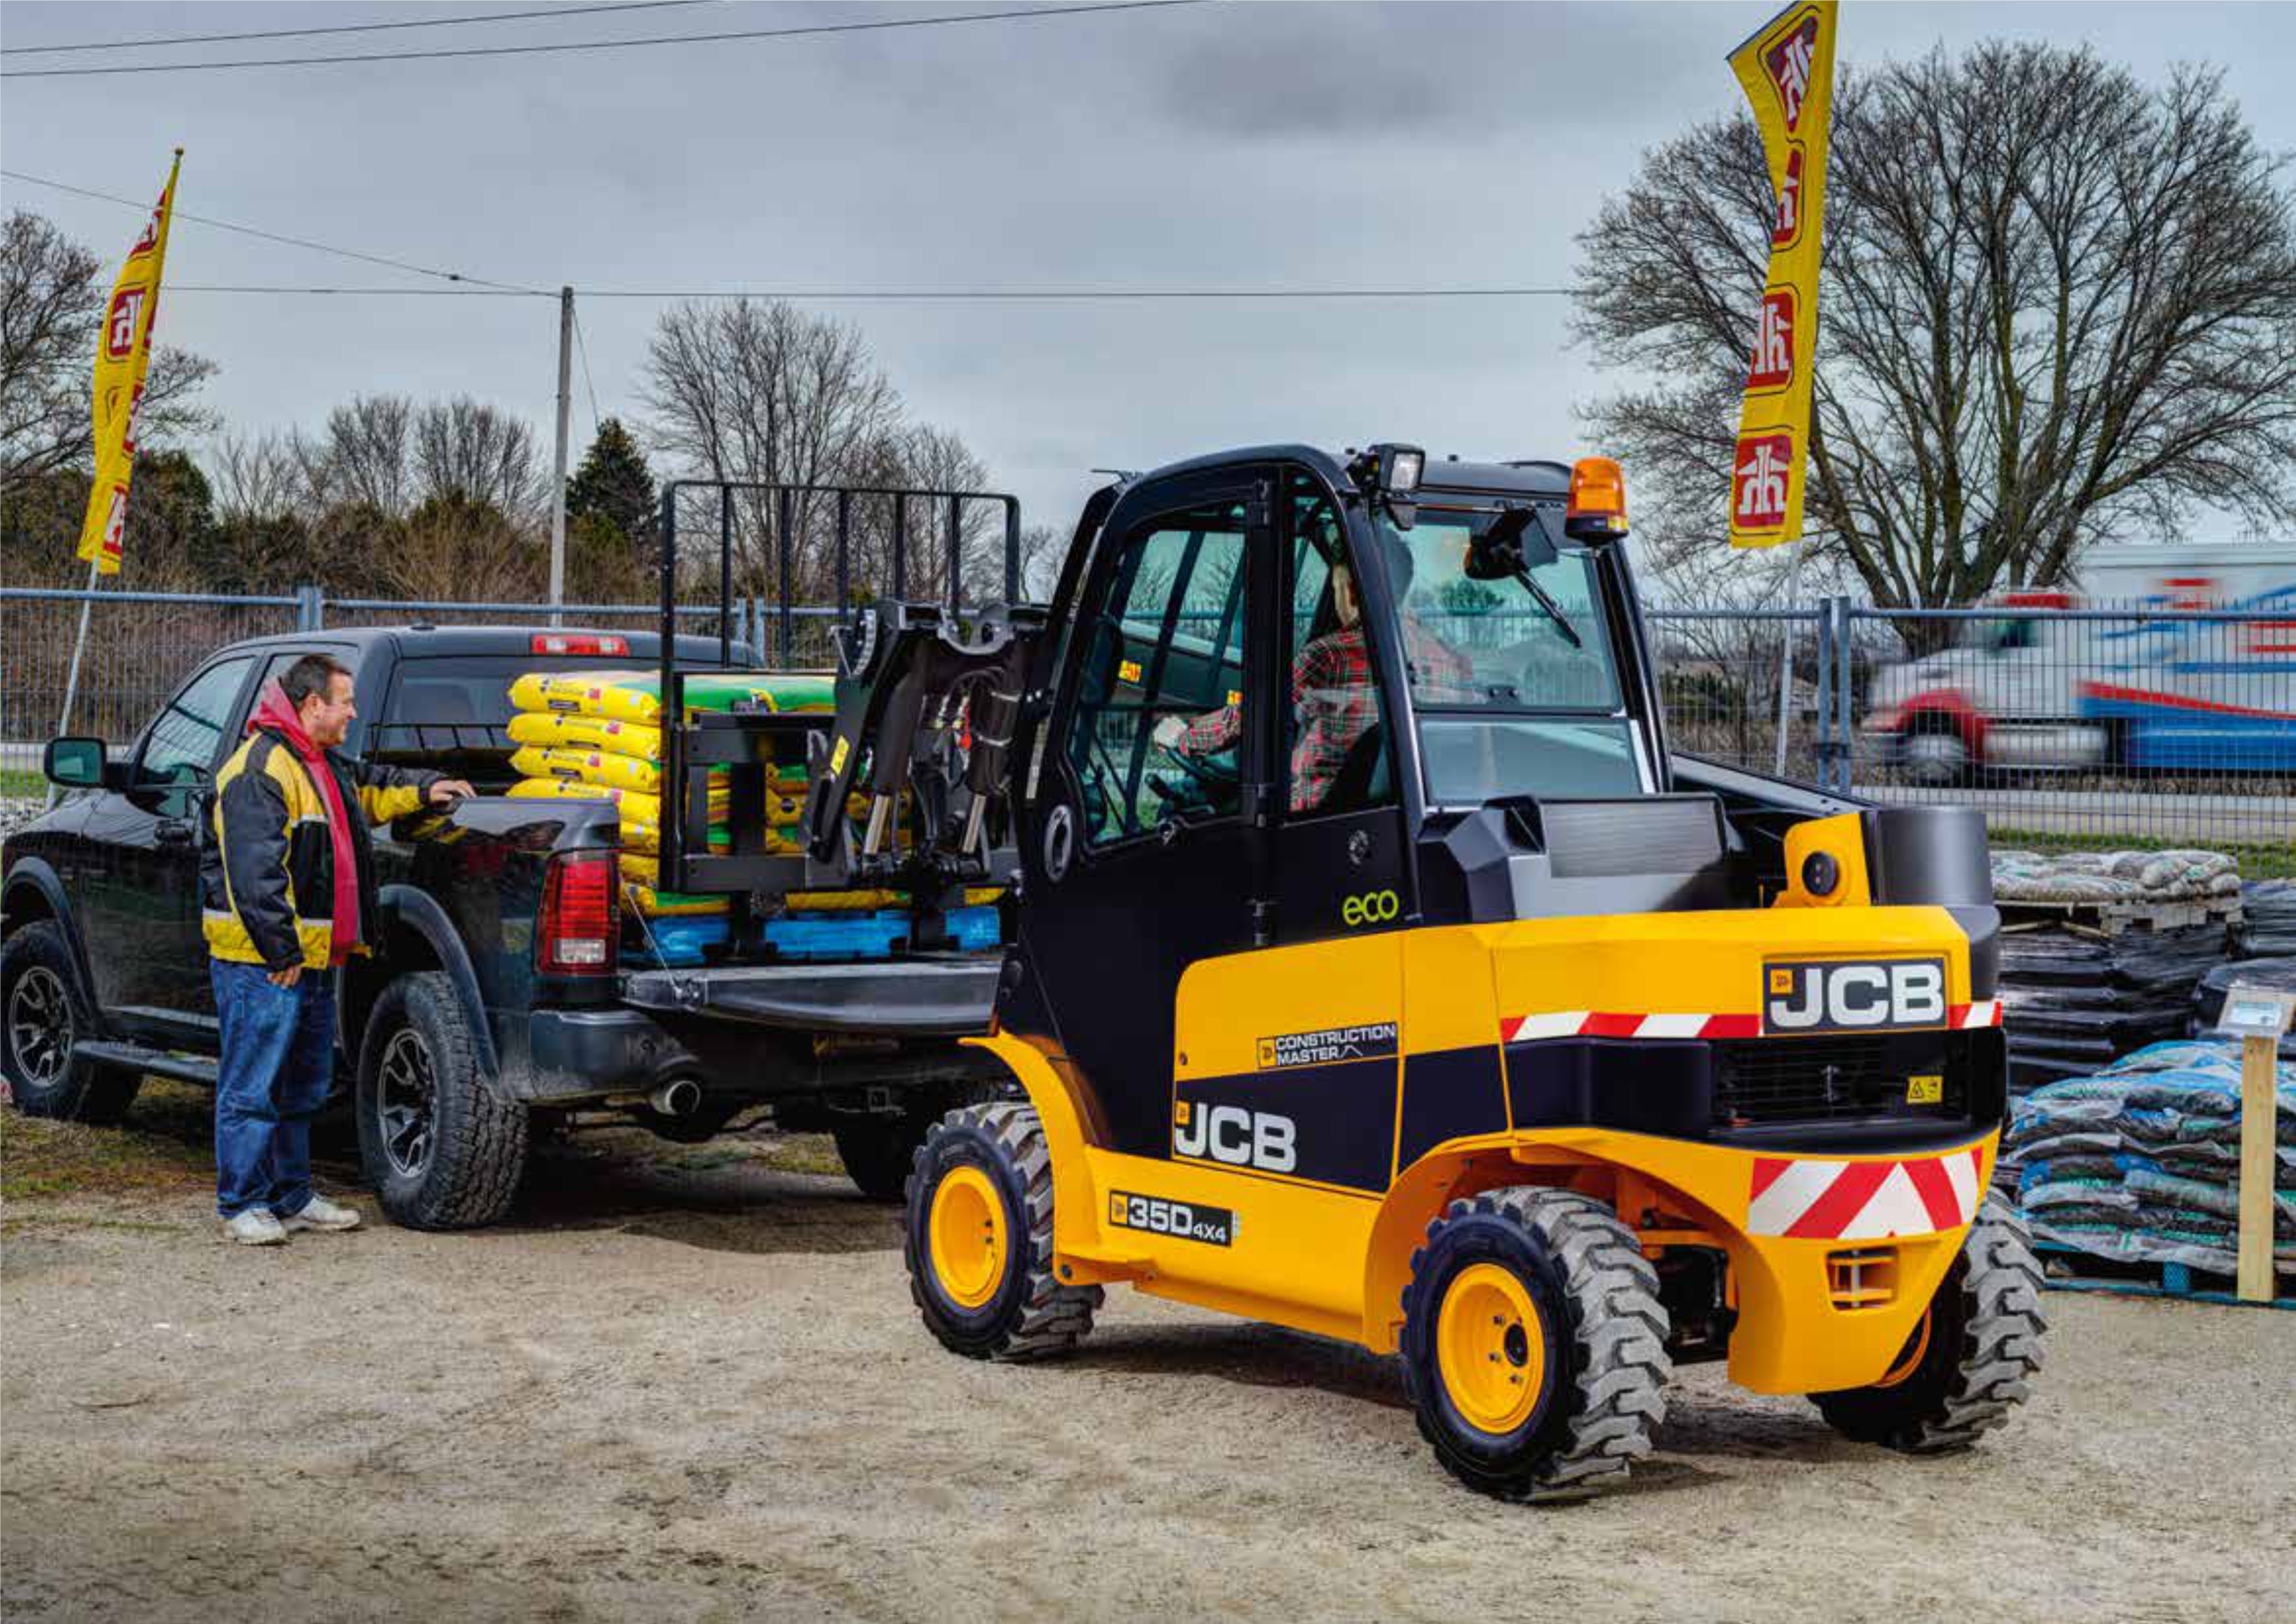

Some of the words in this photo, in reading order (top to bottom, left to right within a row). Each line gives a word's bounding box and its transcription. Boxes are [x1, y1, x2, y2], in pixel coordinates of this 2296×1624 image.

[1343, 890, 1399, 926] eco
[1770, 964, 1944, 1027] JCB
[1276, 1024, 1396, 1050] CONSTRUCTION
[1277, 1047, 1337, 1066] MASTER
[1175, 1102, 1297, 1172] JCB
[1128, 1197, 1193, 1235] 35D
